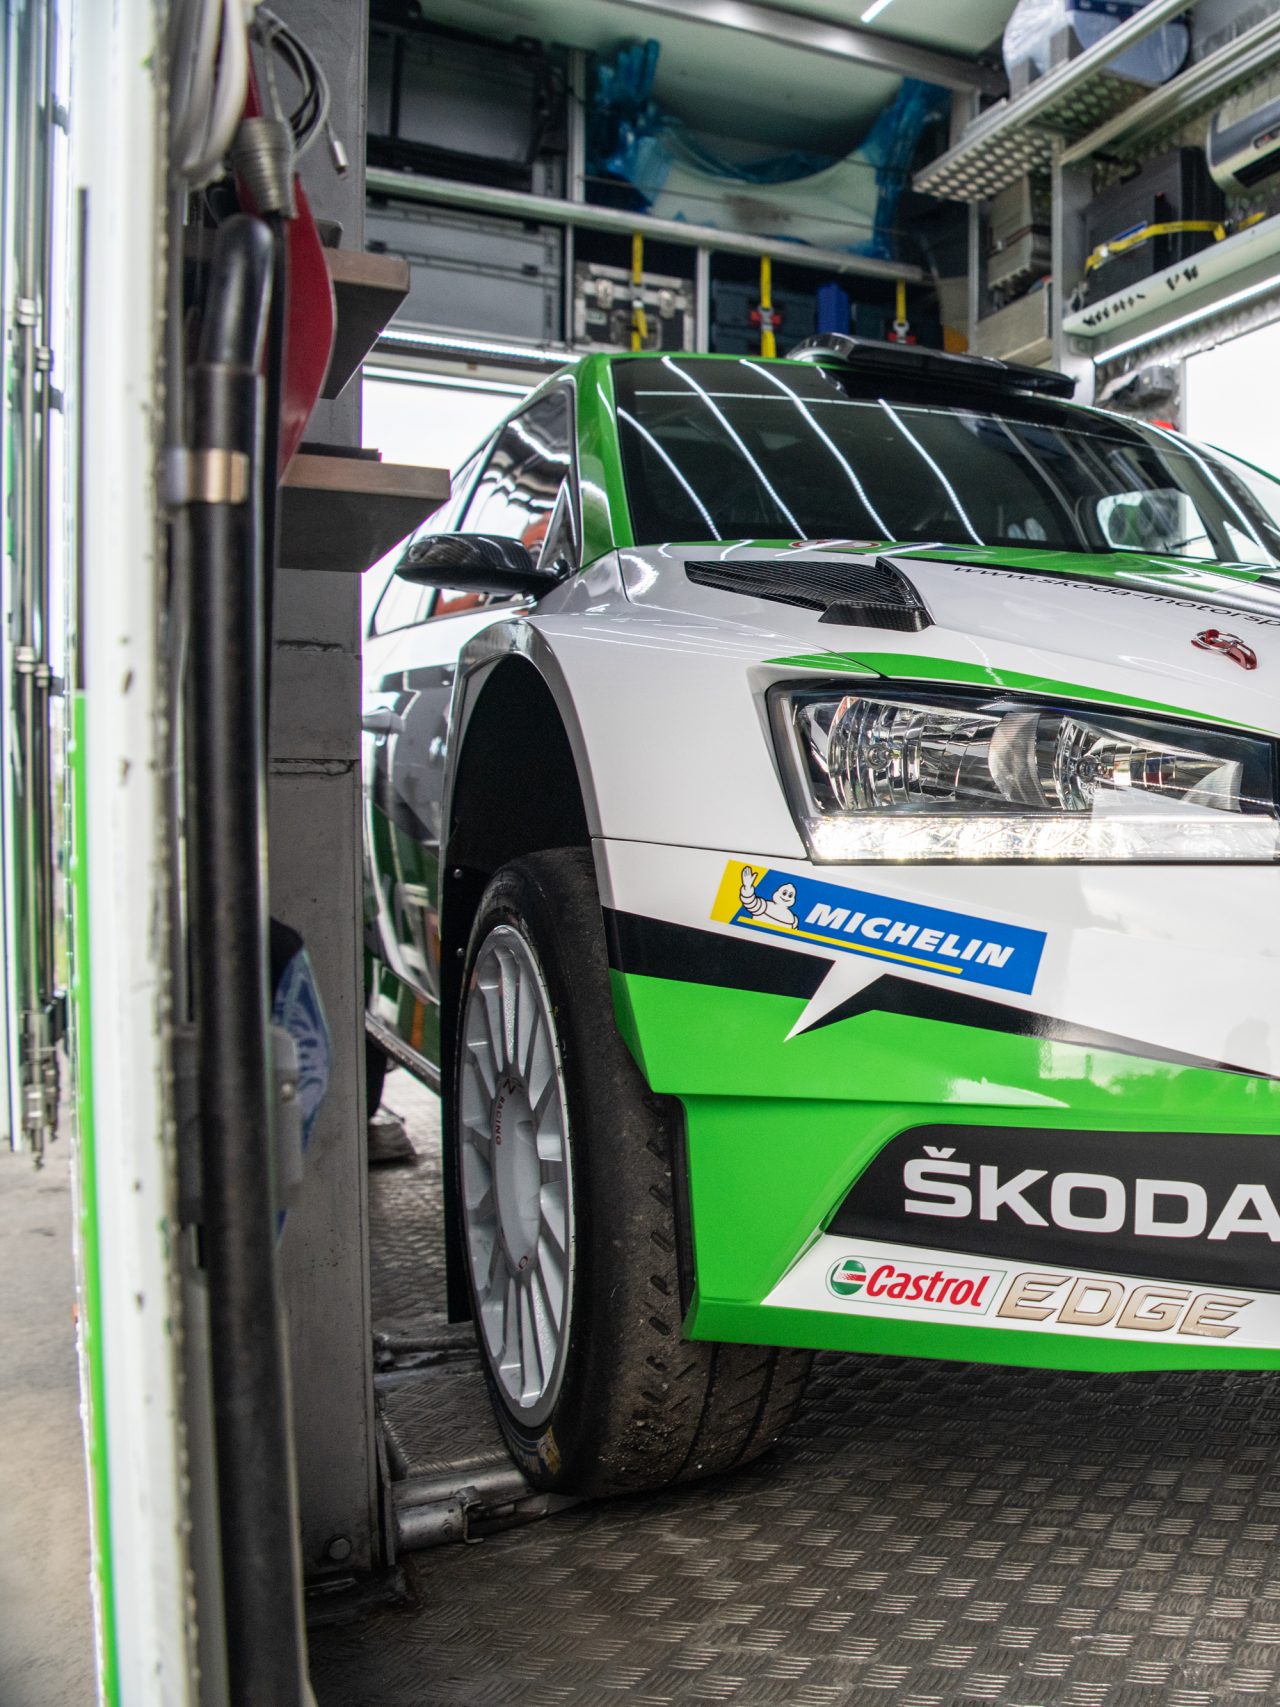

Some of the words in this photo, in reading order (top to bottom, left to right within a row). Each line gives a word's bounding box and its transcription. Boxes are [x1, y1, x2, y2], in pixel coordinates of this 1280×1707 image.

[804, 902, 1015, 968] MICHELIN
[866, 1264, 991, 1307] Castrol
[995, 1271, 1257, 1339] EDGE
